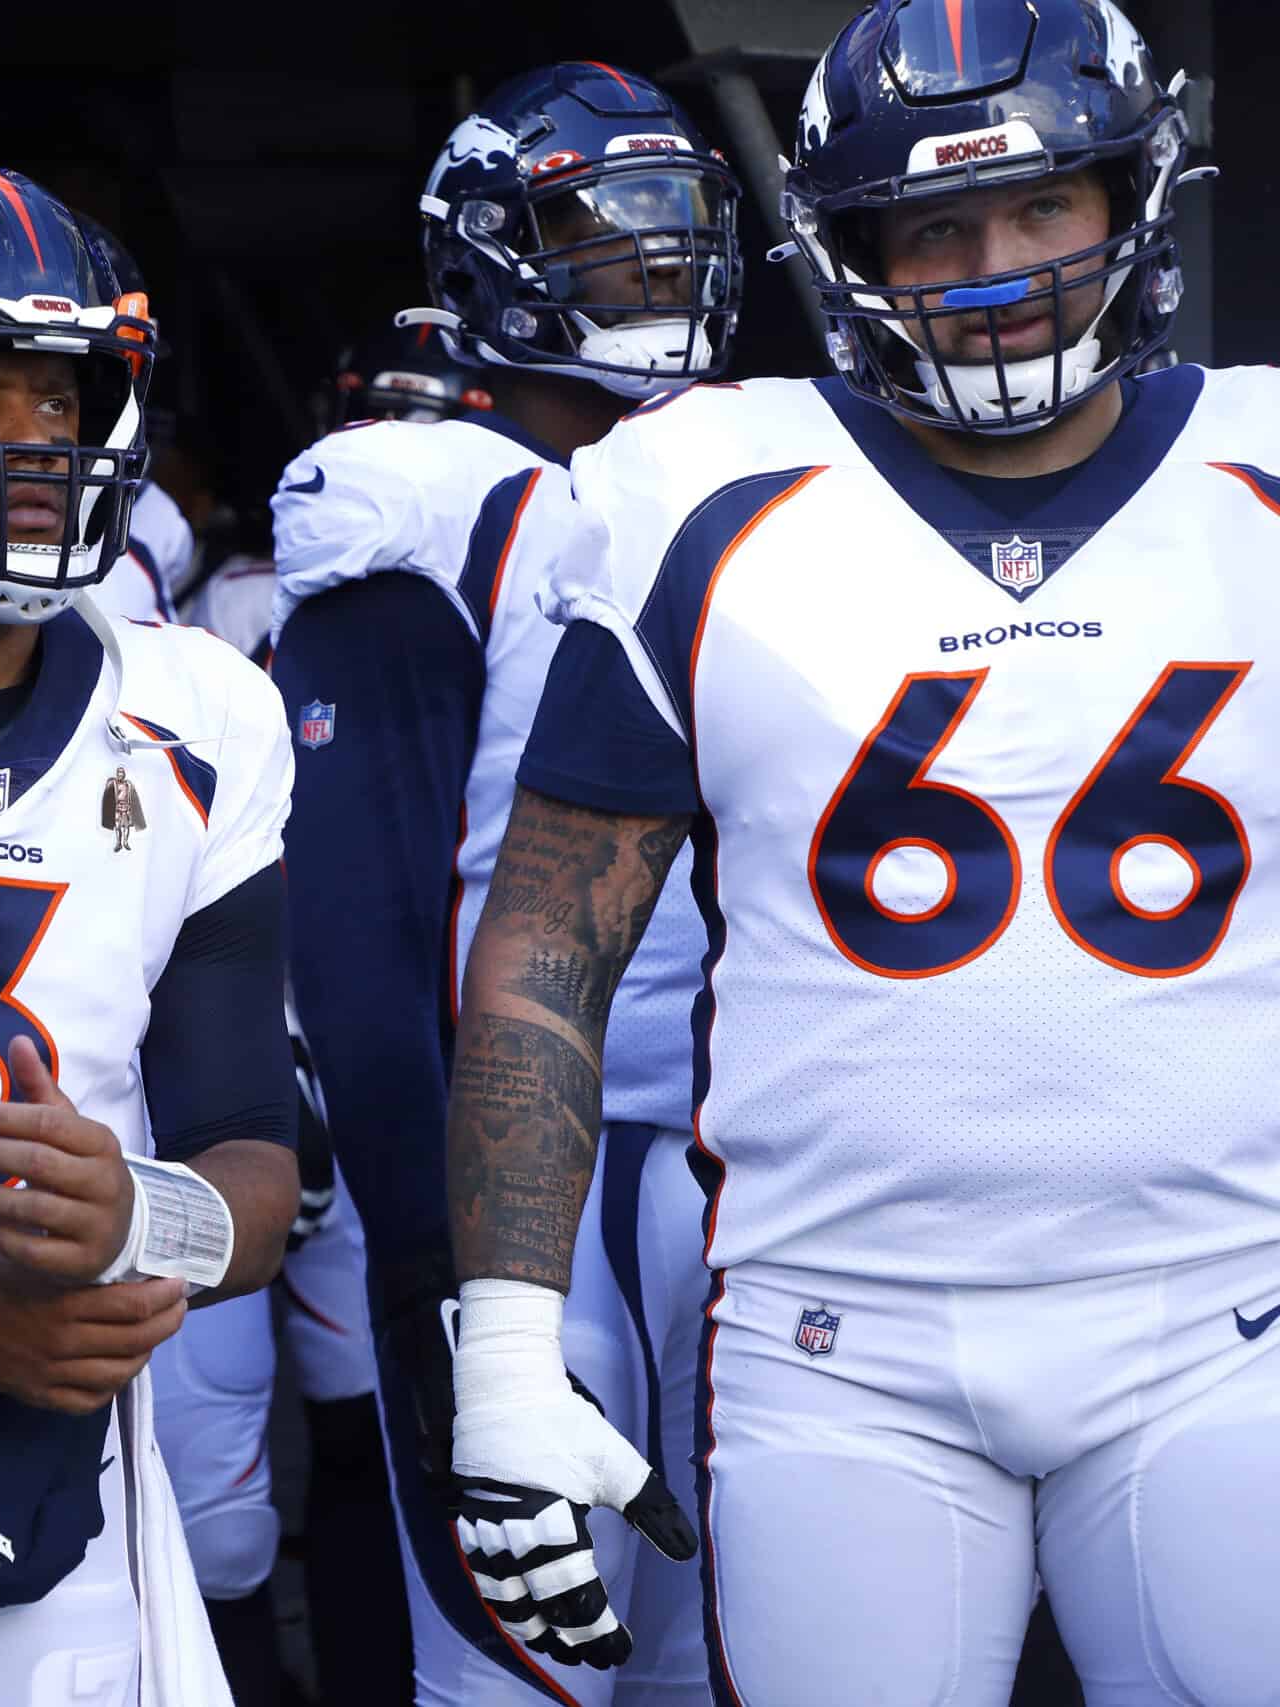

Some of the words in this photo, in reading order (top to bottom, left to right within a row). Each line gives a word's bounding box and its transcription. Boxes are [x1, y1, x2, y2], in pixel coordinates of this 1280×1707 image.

[935, 134, 1008, 166] BRONCOS
[1001, 561, 1035, 580] NFL
[939, 621, 1103, 653] BRONCOS
[808, 661, 1255, 980] 66
[799, 1326, 830, 1350] NFL
